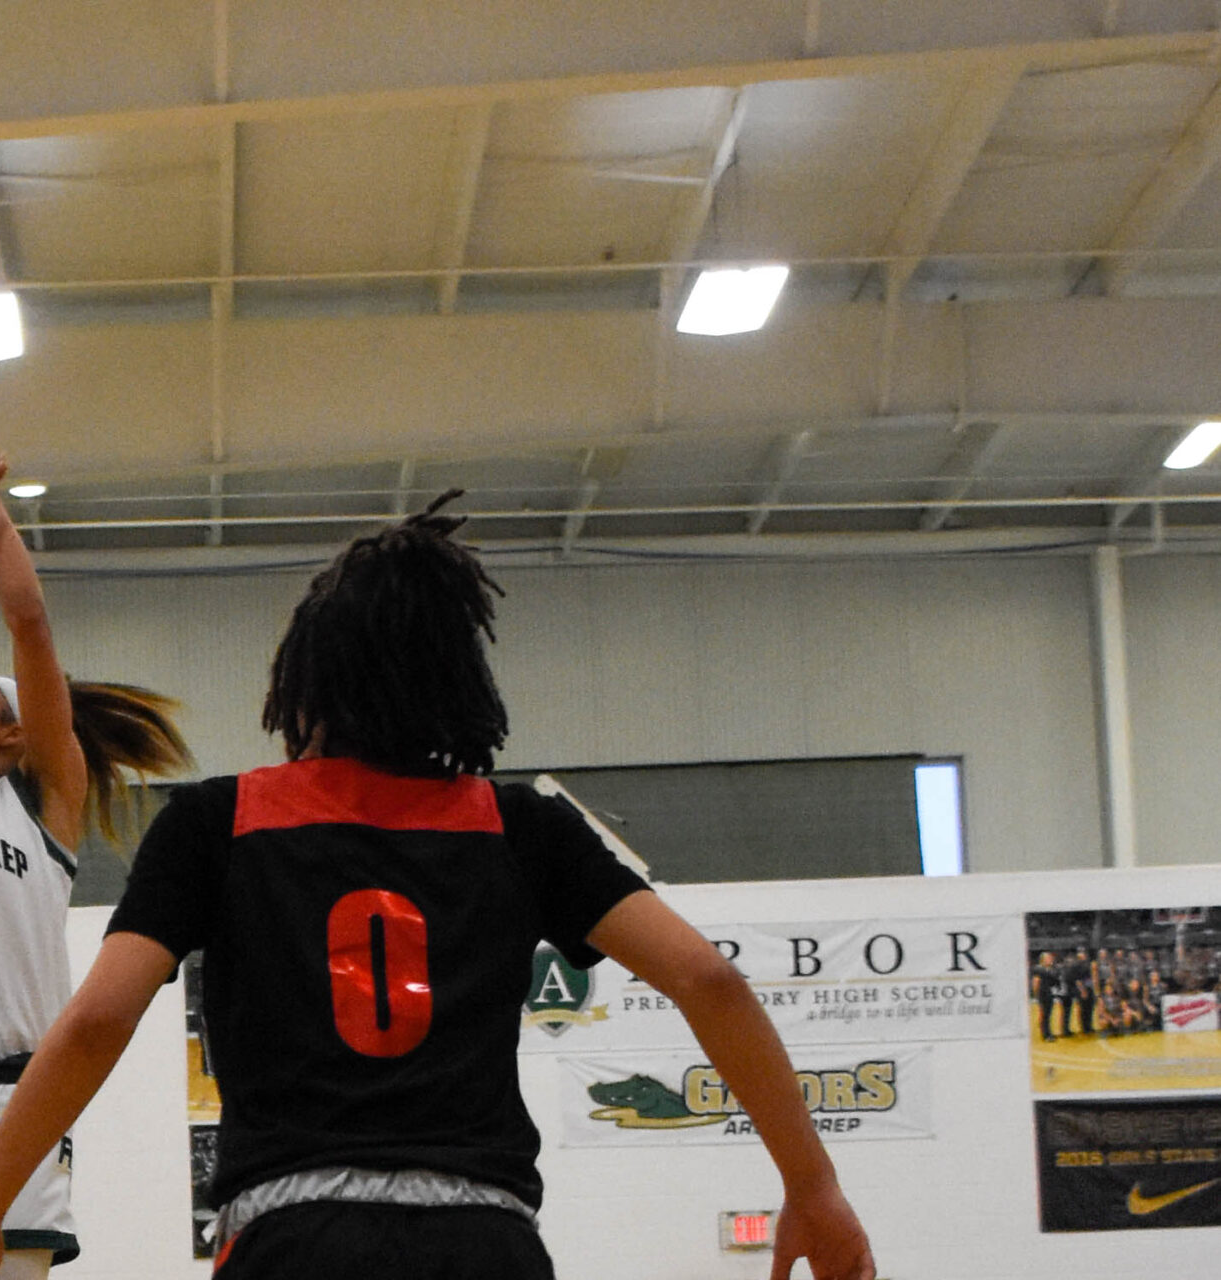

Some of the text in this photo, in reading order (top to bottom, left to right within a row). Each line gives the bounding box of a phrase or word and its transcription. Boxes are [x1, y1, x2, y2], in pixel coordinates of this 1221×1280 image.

[327, 887, 433, 1059] 0
[533, 960, 577, 1003] A
[628, 931, 988, 982] RBOR
[814, 988, 878, 1004] HIGH
[891, 983, 993, 1001] SCHOOL
[683, 1061, 897, 1115] GORS
